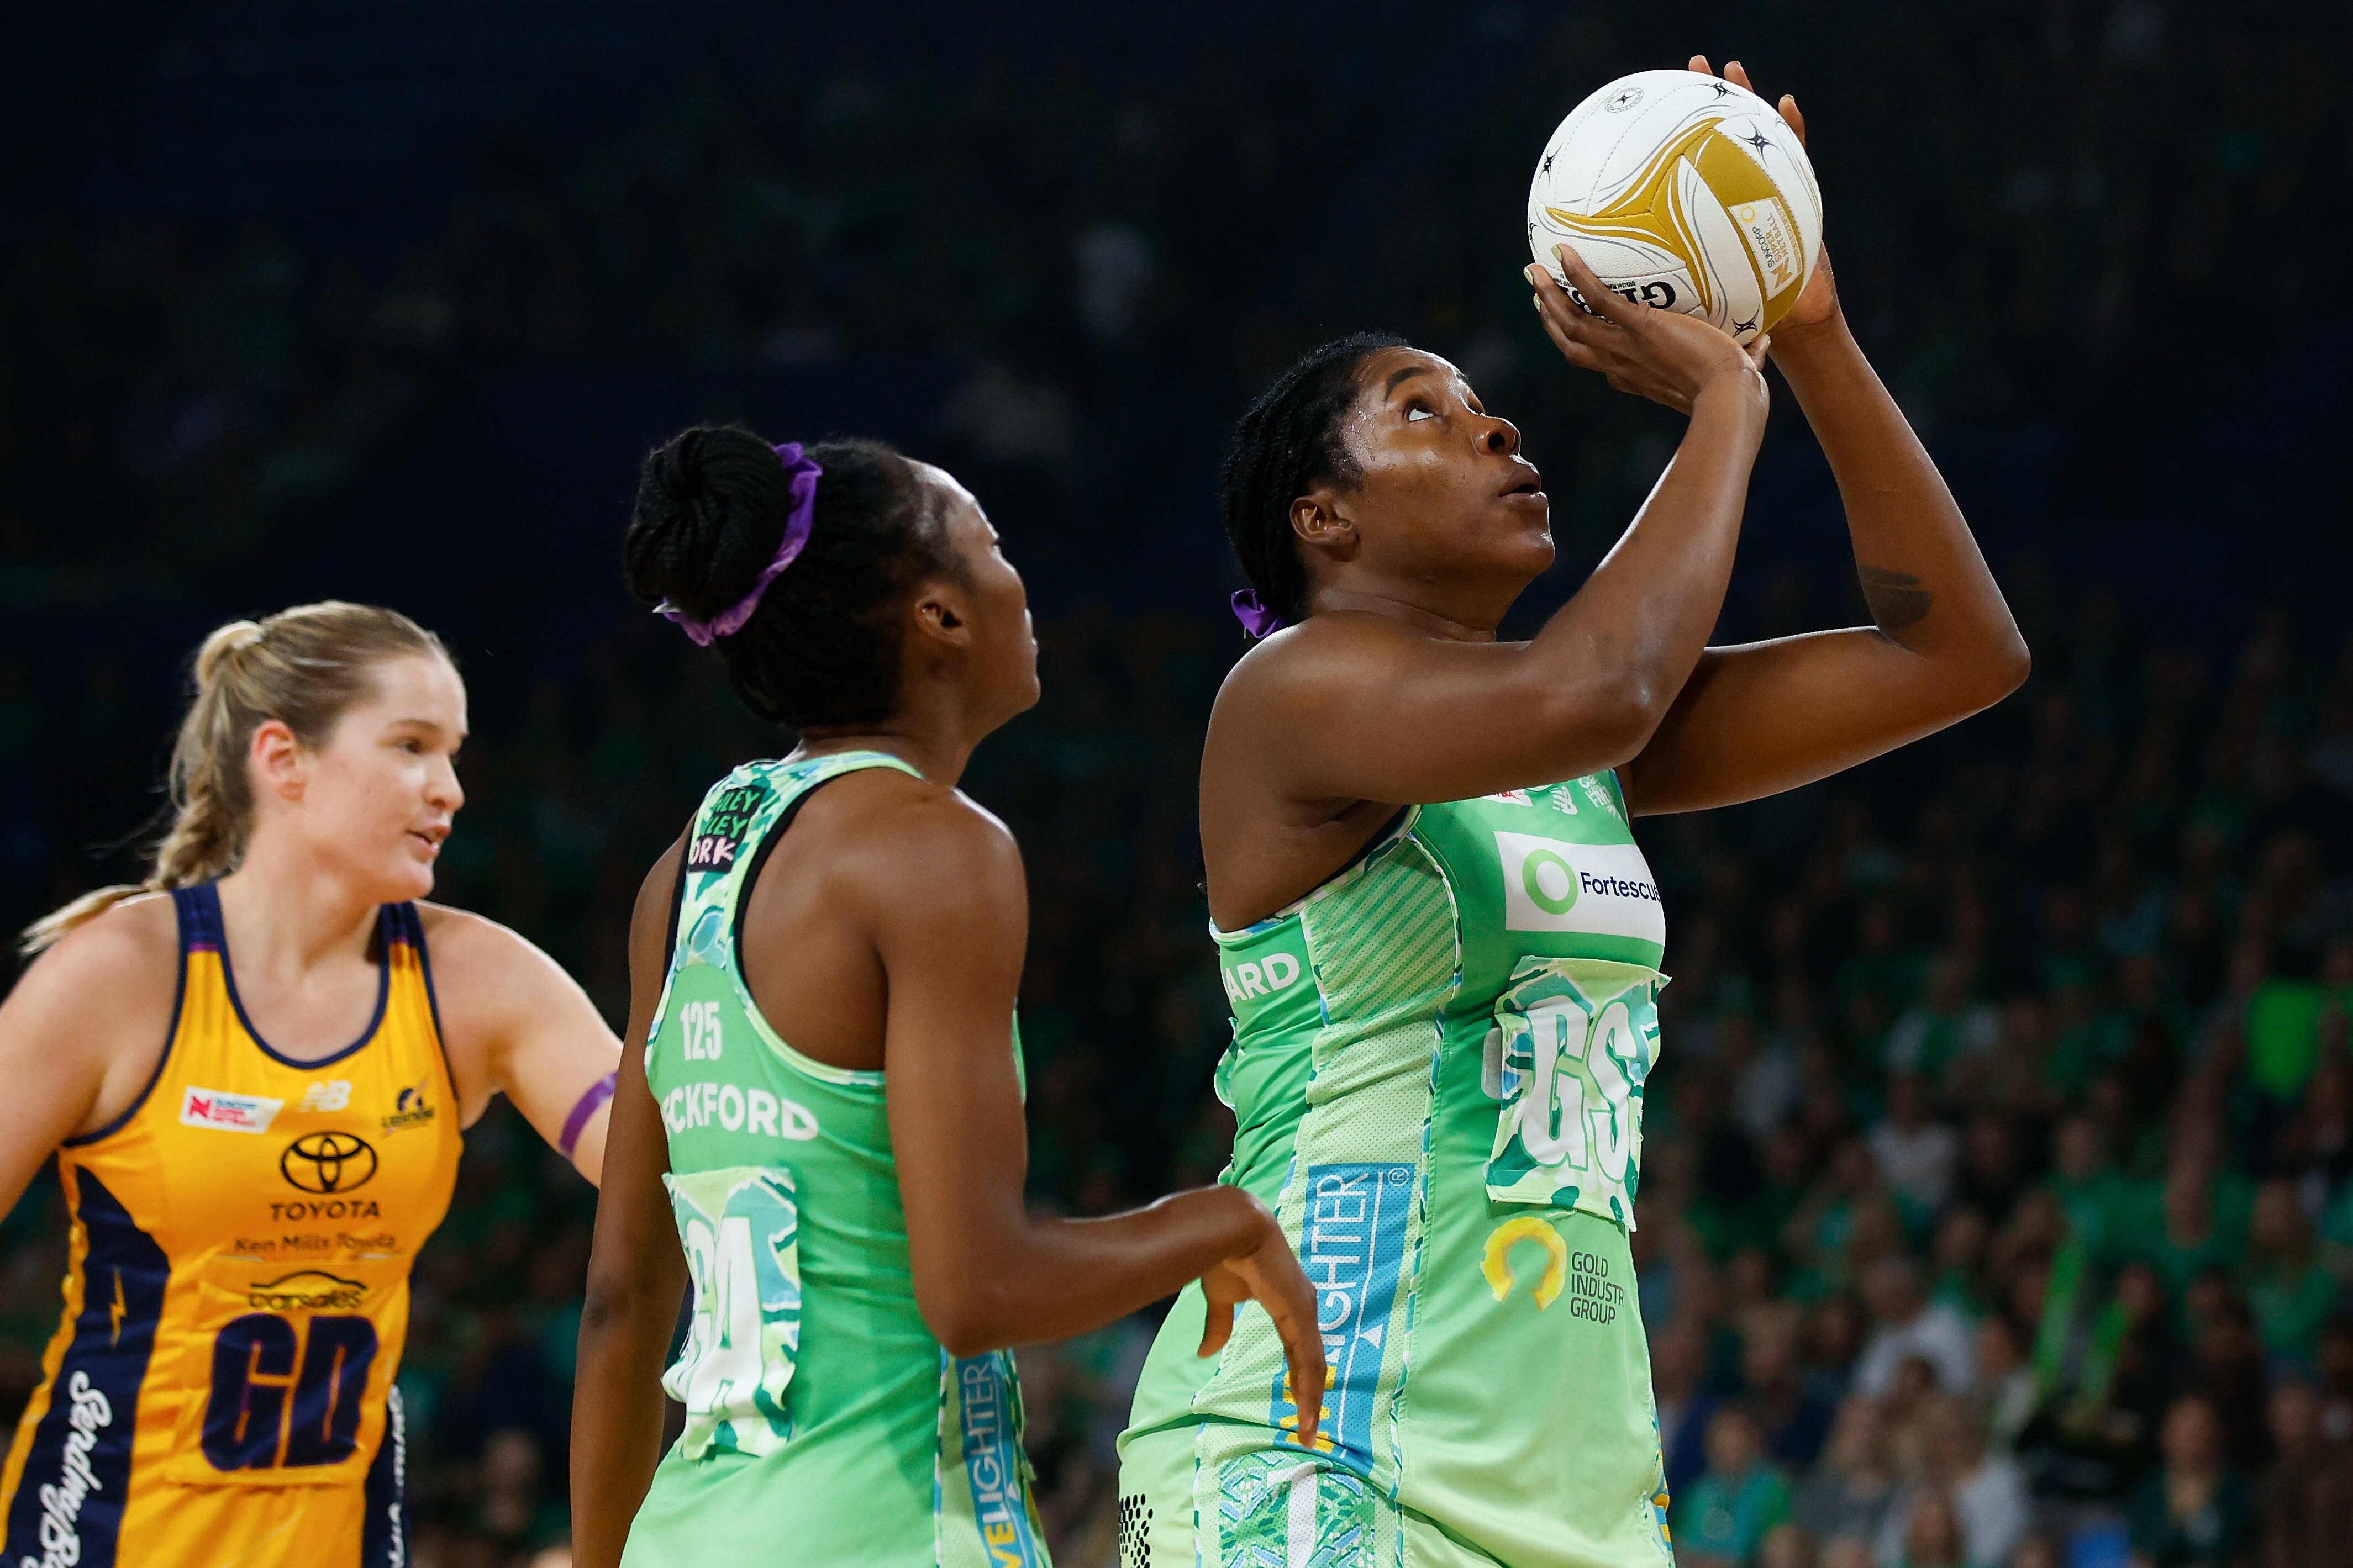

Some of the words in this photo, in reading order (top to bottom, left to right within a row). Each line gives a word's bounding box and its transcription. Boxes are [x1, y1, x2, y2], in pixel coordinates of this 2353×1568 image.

[1752, 226, 1775, 268] SUNCORP
[1766, 229, 1782, 262] SUPER
[1767, 213, 1789, 257] NETBALL
[680, 1001, 722, 1060] 125
[1519, 995, 1639, 1184] GS
[270, 1200, 380, 1222] TOYOTA
[1571, 1252, 1608, 1277] GOLD
[1571, 1274, 1624, 1307] INDUSTR
[1570, 1297, 1615, 1325] GROUP
[199, 1313, 380, 1472] GD
